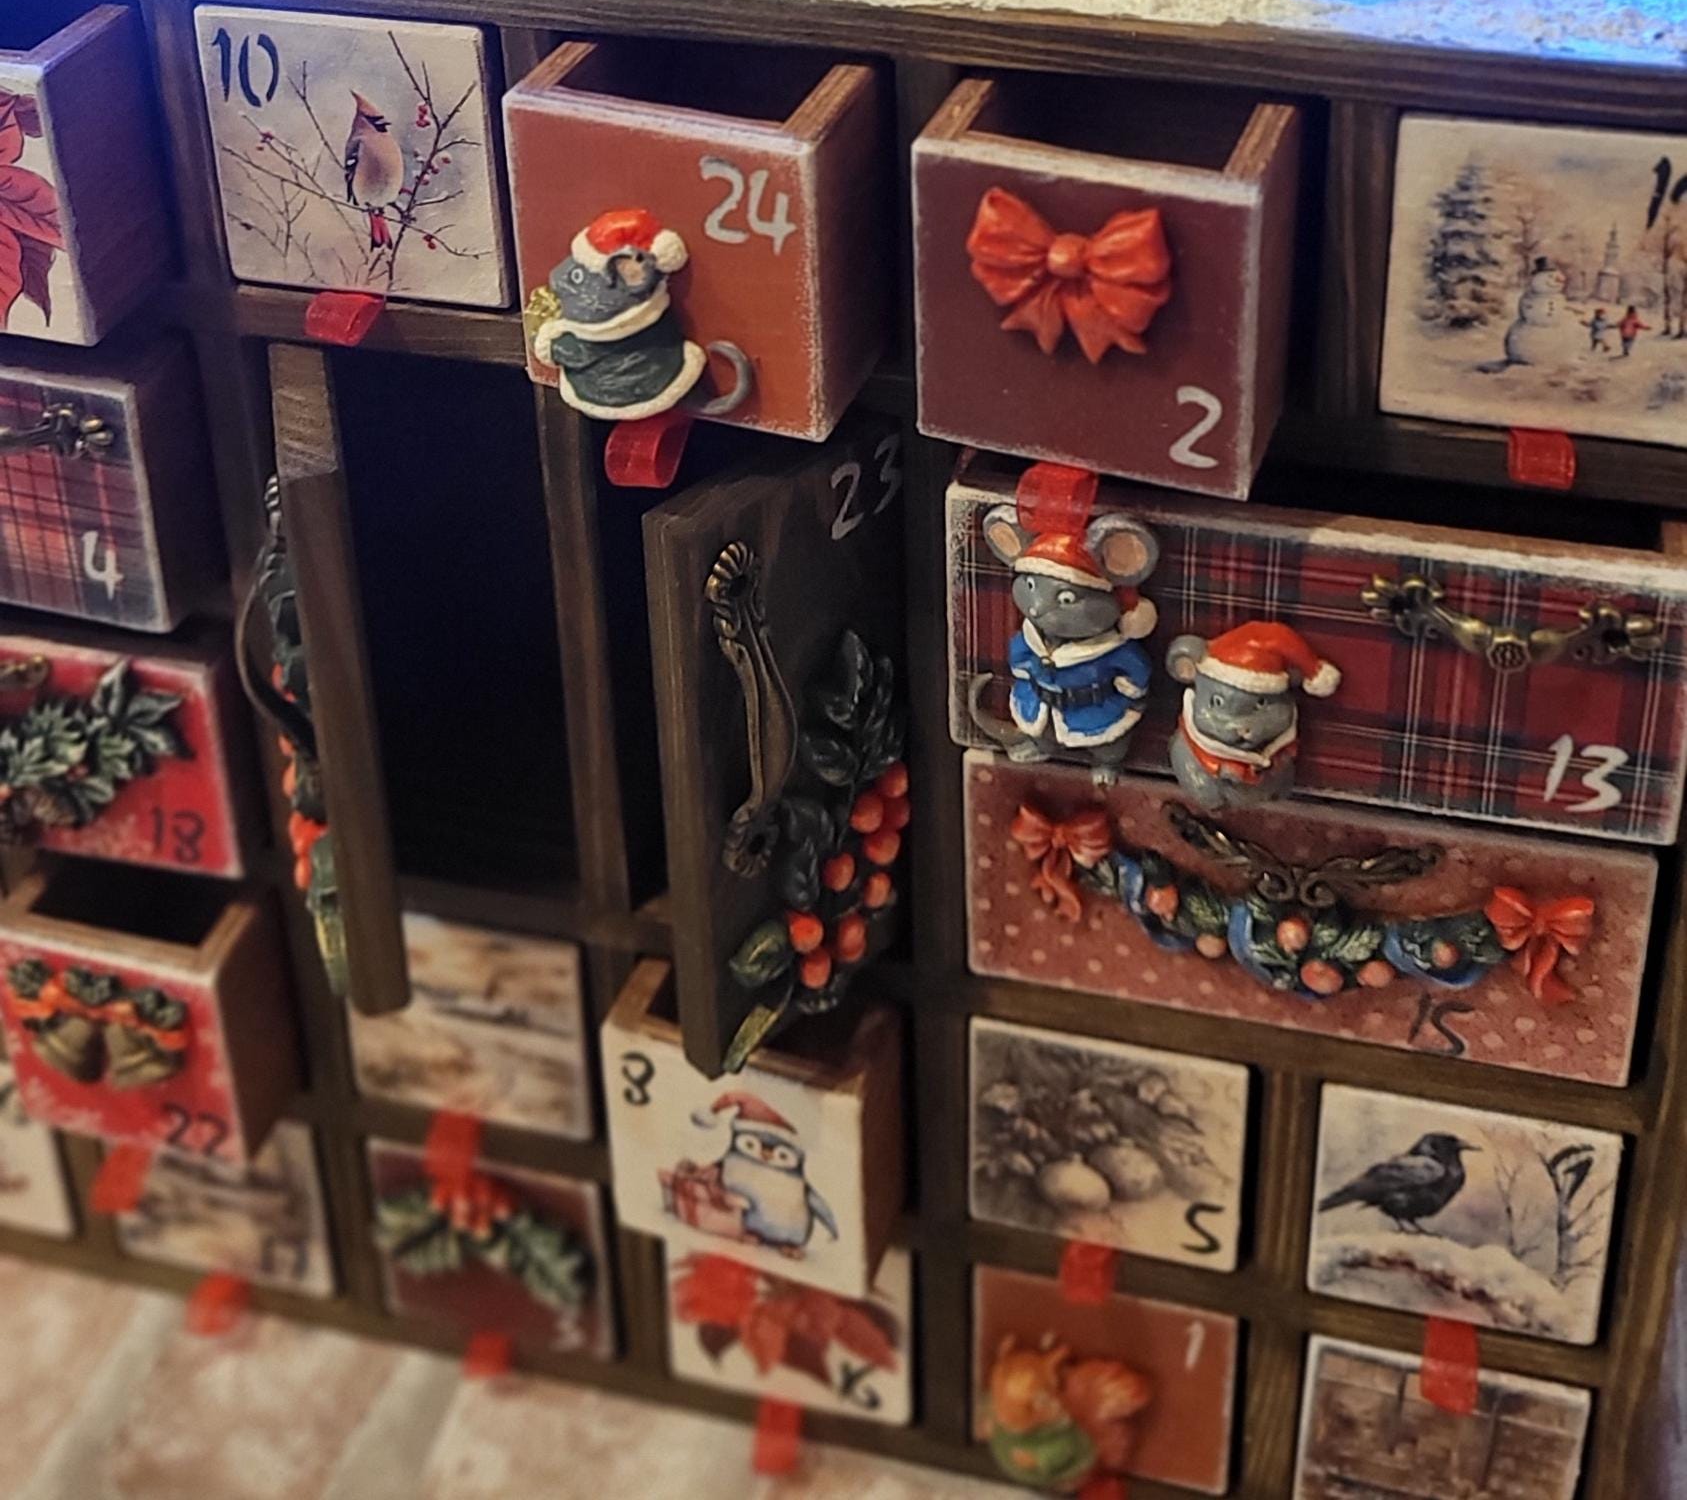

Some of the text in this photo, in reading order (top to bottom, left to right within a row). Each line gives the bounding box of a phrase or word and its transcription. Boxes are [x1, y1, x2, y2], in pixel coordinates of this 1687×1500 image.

[211, 27, 280, 108] 10
[700, 155, 798, 256] 24
[1646, 155, 1687, 231] 1
[1169, 385, 1222, 469] 2
[830, 433, 902, 541] 23
[81, 530, 124, 600] 4
[1543, 734, 1630, 813] 13
[152, 806, 205, 863] 18
[1406, 991, 1476, 1057] 15
[621, 1051, 656, 1107] 8
[161, 1102, 236, 1162] 22
[1181, 1201, 1225, 1256] 5
[1184, 1320, 1206, 1374] 1
